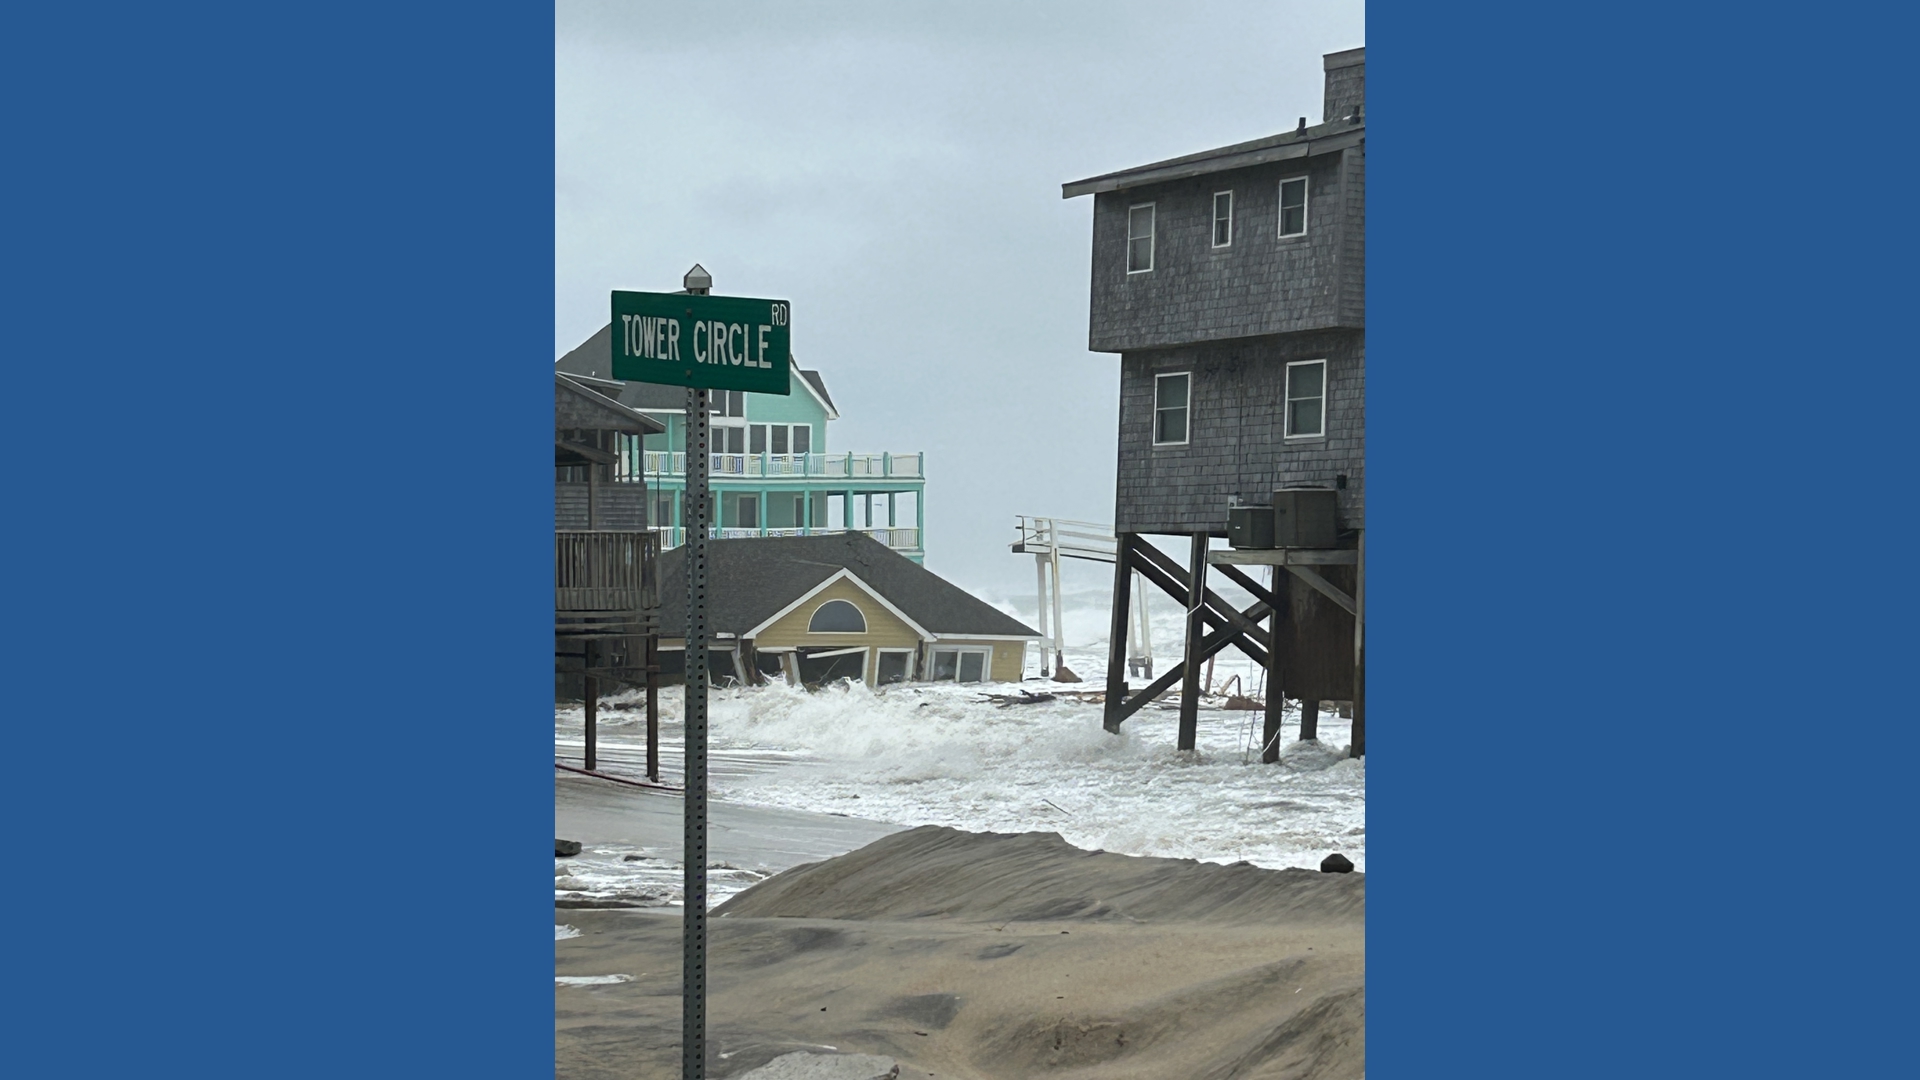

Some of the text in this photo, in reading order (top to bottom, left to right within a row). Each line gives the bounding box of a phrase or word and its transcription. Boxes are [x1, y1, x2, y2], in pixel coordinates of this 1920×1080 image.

[622, 303, 787, 368] TOWER CIRCLE RD
